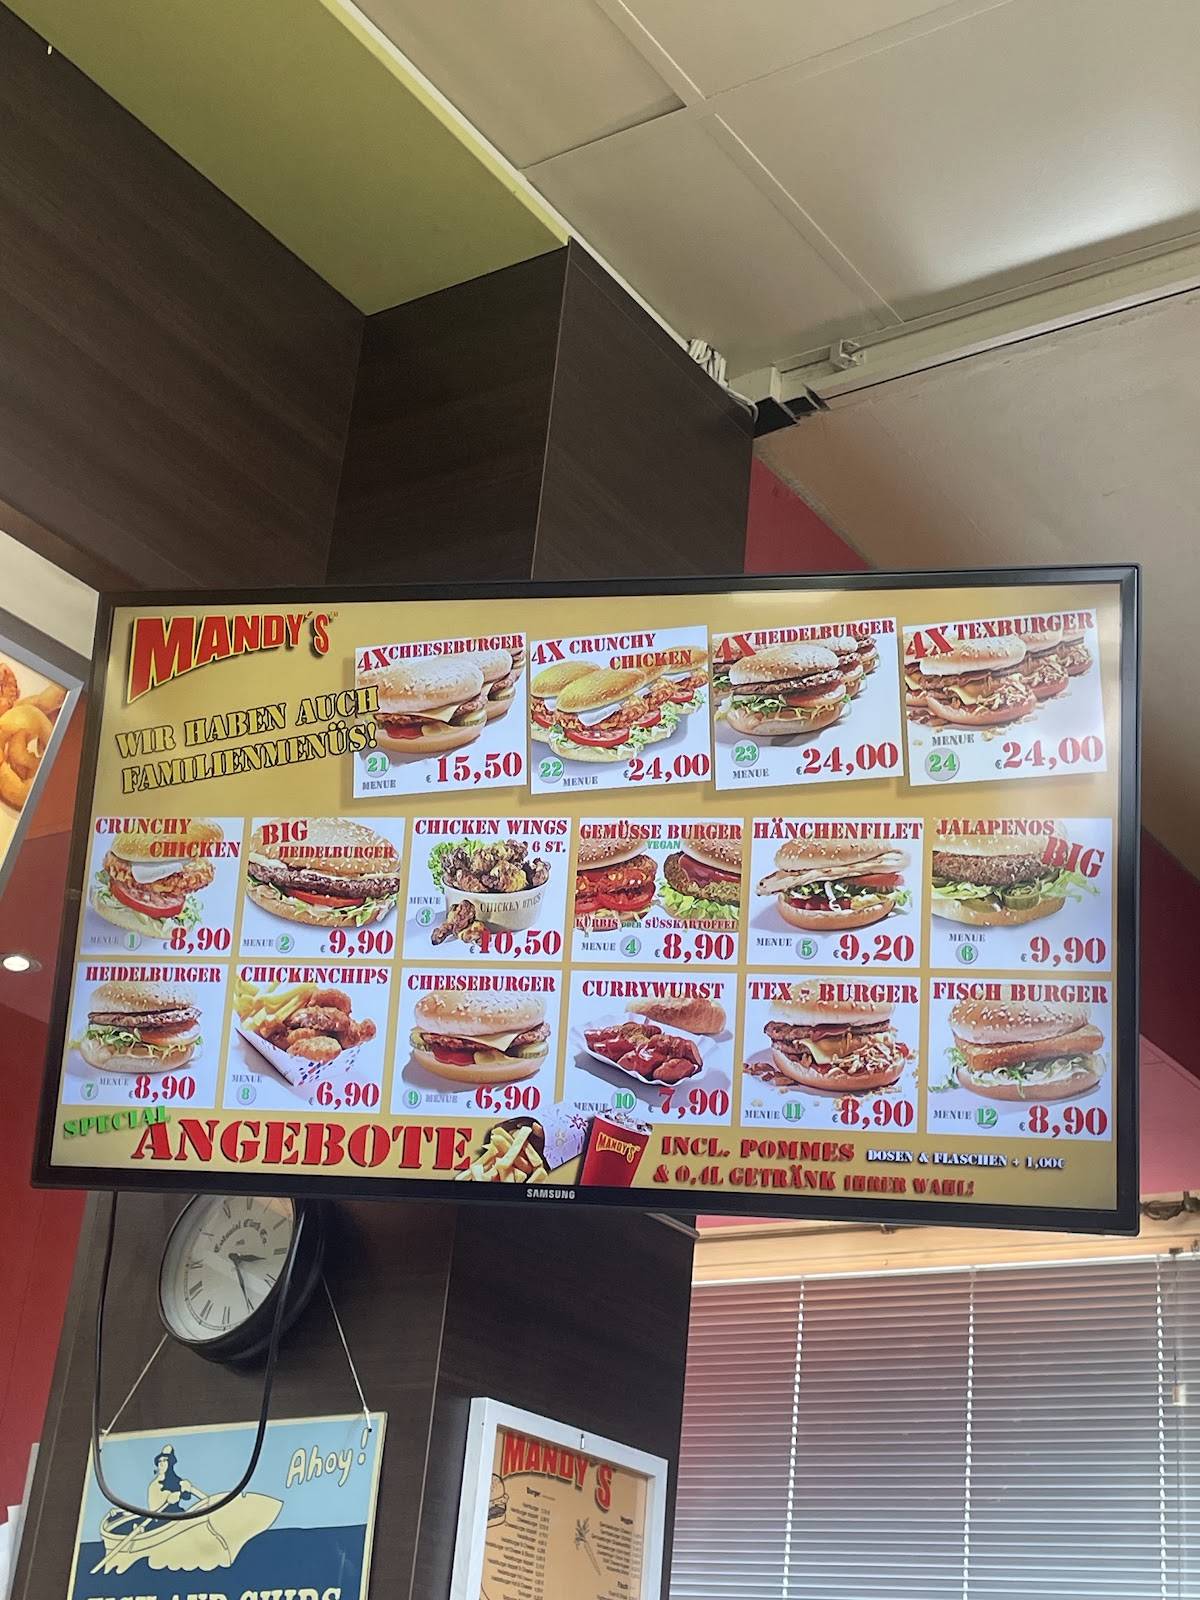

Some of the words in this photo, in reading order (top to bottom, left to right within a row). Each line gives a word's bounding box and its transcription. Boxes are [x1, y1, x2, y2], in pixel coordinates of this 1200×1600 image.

[715, 633, 757, 659] 4X
[754, 619, 895, 646] HEIDELBURGER
[906, 627, 954, 660] 4X
[953, 611, 1094, 641] TEXBURGER
[389, 633, 523, 659] CHEESEBURGER
[532, 640, 565, 664] 4X
[569, 633, 656, 655] CRUNCHY
[609, 649, 692, 670] CHICKEN
[117, 725, 176, 759] WIR
[185, 705, 287, 746] HABEN
[296, 686, 379, 724] AUCH
[931, 733, 975, 747] MENUE
[122, 722, 378, 794] FAMILIENMENÜS!
[735, 745, 757, 761] 23
[796, 741, 898, 776] €24,00
[995, 735, 1103, 770] €24,00
[367, 756, 389, 773] 21
[426, 750, 522, 785] €15,50
[623, 753, 710, 782] €24,00
[928, 753, 957, 773] 24
[540, 761, 563, 778] 22
[563, 776, 598, 787] MENUE
[732, 768, 769, 779] MENUE
[362, 779, 396, 791] MENUE
[95, 818, 192, 834] CRUNCHY
[261, 821, 308, 845] BIG
[415, 819, 501, 835] CHICKEN
[506, 819, 568, 835] WINGS
[580, 820, 662, 840] GEMÜSSE
[667, 824, 742, 840] BURGER
[753, 817, 922, 840] HÄNCHENFILET
[936, 819, 1055, 836] JALAPENOS
[149, 841, 241, 858] CHICKEN
[280, 846, 394, 859] HEIDELBURGER
[532, 841, 541, 852] 6
[545, 841, 566, 853] ST.
[646, 841, 681, 850] VEGAN
[1040, 836, 1104, 878] BIG
[409, 897, 440, 905] MENUE
[421, 910, 430, 923] 3
[575, 917, 619, 929] KÜRBIS
[89, 936, 119, 945] MENUE
[128, 933, 136, 948] 1
[162, 927, 231, 954] €8,90
[243, 939, 274, 948] MENUE
[280, 934, 290, 950] 2
[320, 930, 394, 958] €9,90
[581, 941, 616, 951] MENUE
[624, 939, 637, 953] 4
[654, 933, 735, 962] €8,90
[756, 938, 792, 947] MENUE
[800, 940, 813, 956] 5
[949, 933, 986, 942] MENUE
[833, 934, 915, 964] €9,20
[961, 946, 973, 960] 6
[1020, 936, 1105, 967] €9,90
[85, 966, 221, 983] HEIDELBURGER
[240, 967, 389, 984] CHICKENCHIPS
[408, 975, 556, 992] CHEESEBURGER
[582, 980, 725, 999] CURRYWURST
[749, 982, 792, 1001] TEX
[819, 982, 918, 1004] BURGER
[933, 982, 1002, 1001] FISCH
[1010, 983, 1108, 1004] BURGER
[86, 1083, 94, 1098] 7
[99, 1078, 129, 1086] MENUE
[128, 1074, 196, 1102] €8,90
[231, 1075, 262, 1083] MENUE
[241, 1087, 250, 1100] 8
[308, 1081, 379, 1109] €6,90
[407, 1091, 419, 1105] 9
[425, 1094, 458, 1103] MENUE
[466, 1086, 541, 1113] €6,90
[574, 1102, 607, 1112] MENUE
[614, 1093, 635, 1110] 10
[648, 1086, 729, 1117] €7,90
[744, 1110, 780, 1119] MENUE
[784, 1103, 801, 1120] 11
[832, 1098, 914, 1129] €8,90
[933, 1109, 972, 1120] MENUE
[977, 1107, 998, 1125] 12
[1019, 1104, 1108, 1138] €8,90
[63, 1105, 170, 1139] SPECIAL
[130, 1119, 473, 1169] ANGEBOTE
[661, 1136, 730, 1158] INCL.
[740, 1139, 855, 1162] POMMES
[867, 1149, 913, 1162] DOSEN
[919, 1153, 929, 1163] &
[932, 1151, 1008, 1167] FLASCHEN
[653, 1164, 669, 1184] &
[729, 1164, 836, 1191] GETRÄNK
[843, 1174, 906, 1193] IHRER
[913, 1178, 975, 1197] WAHL!
[527, 1188, 575, 1200] SAMSUNG
[285, 1427, 370, 1488] Ahoy!
